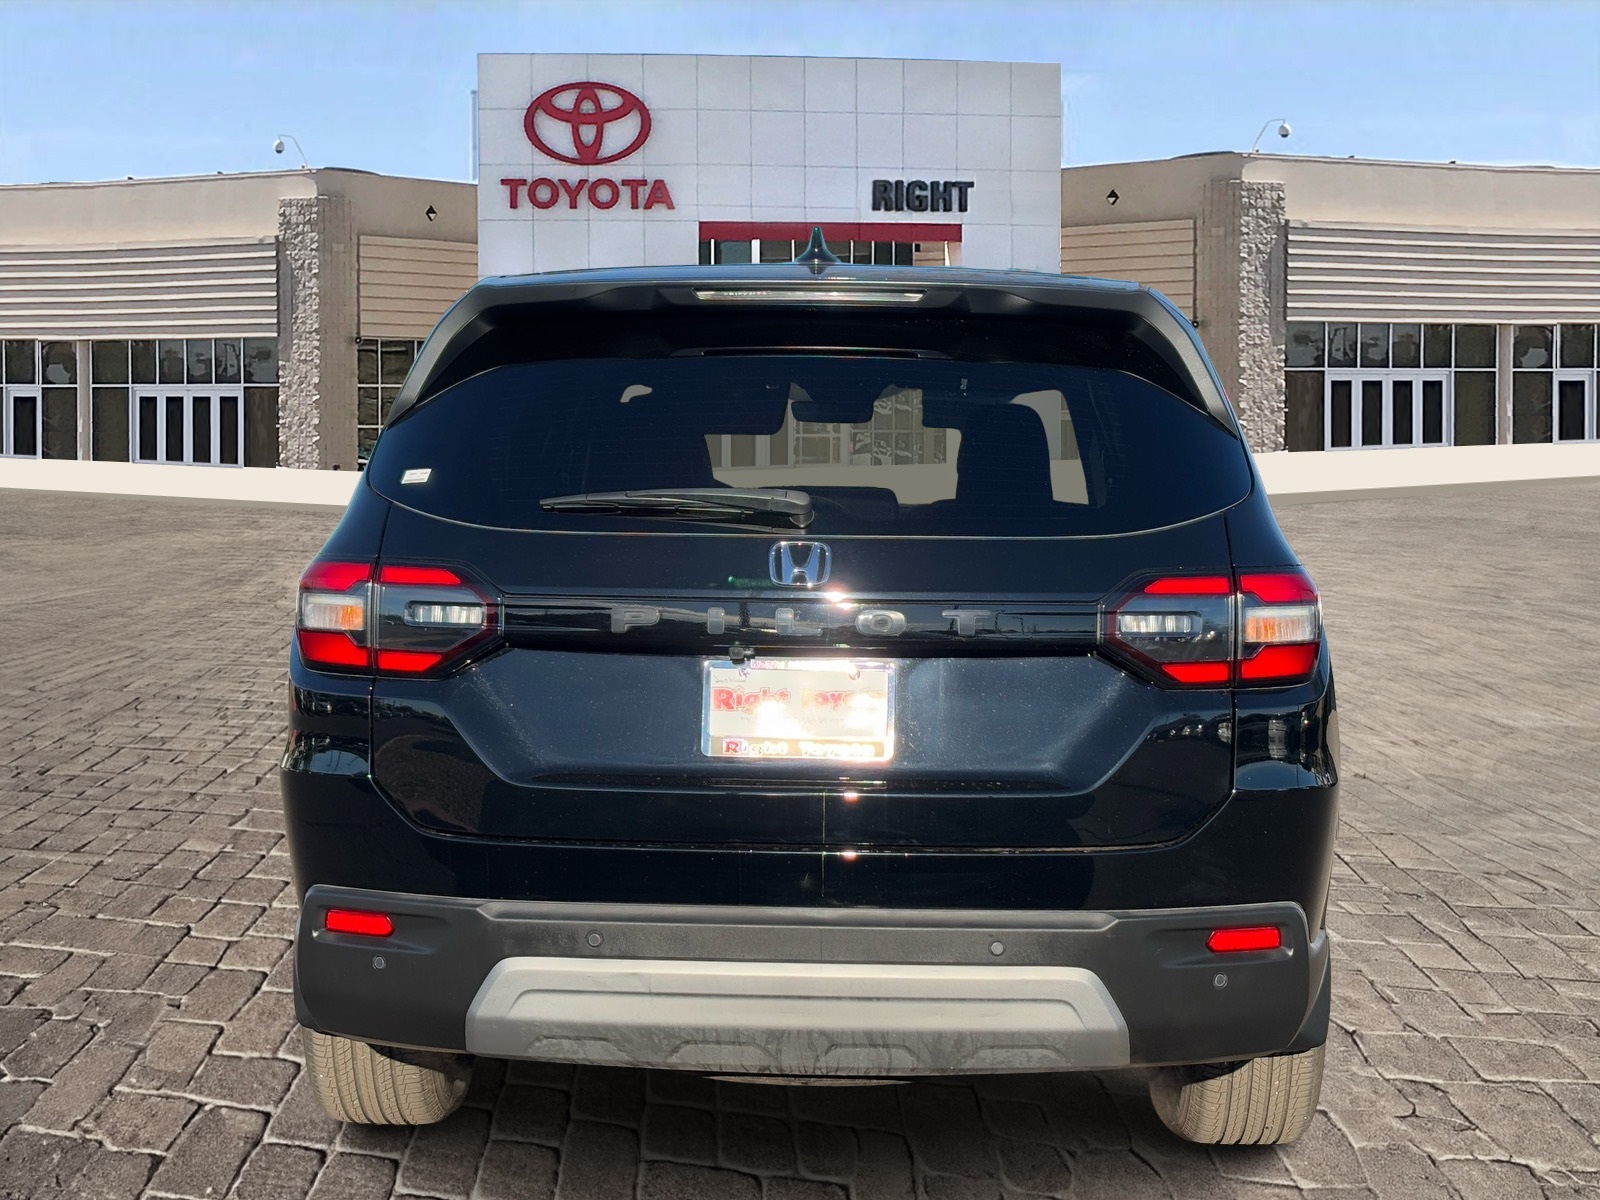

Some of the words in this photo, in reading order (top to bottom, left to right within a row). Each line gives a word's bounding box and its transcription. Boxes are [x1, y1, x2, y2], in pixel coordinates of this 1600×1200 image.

[501, 178, 675, 210] TOYOTA
[871, 179, 975, 213] RIGHT
[610, 606, 991, 637] PILOT
[712, 686, 791, 713] Right
